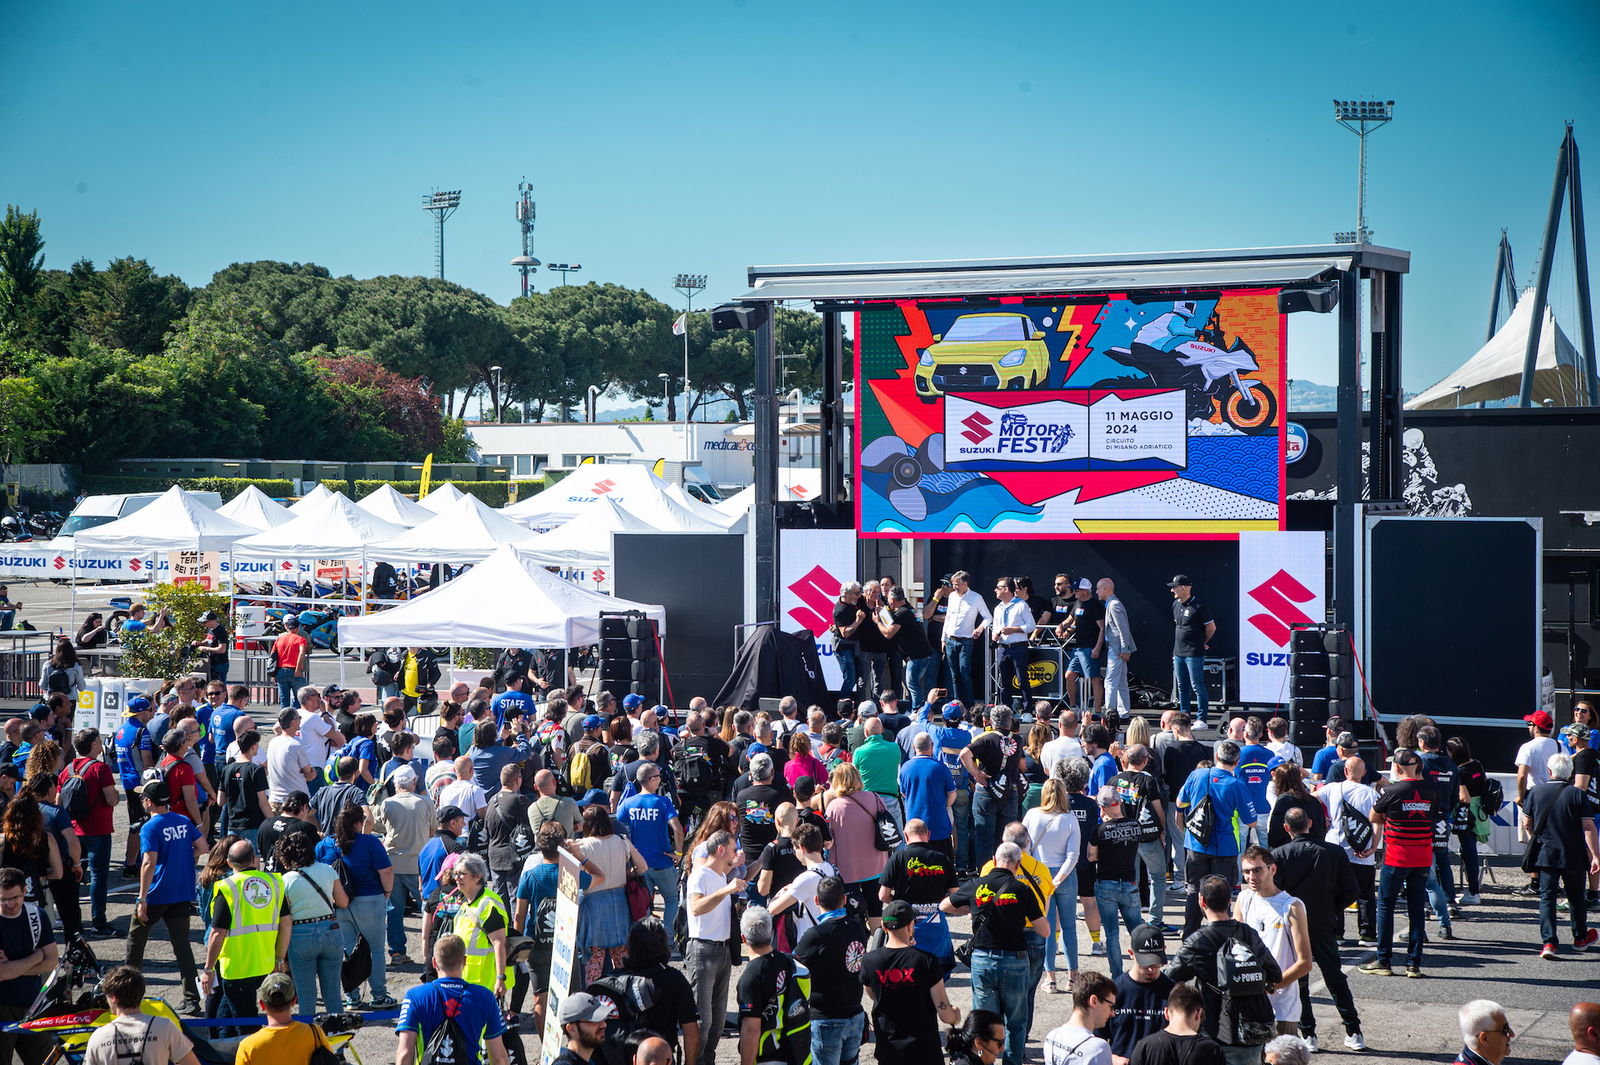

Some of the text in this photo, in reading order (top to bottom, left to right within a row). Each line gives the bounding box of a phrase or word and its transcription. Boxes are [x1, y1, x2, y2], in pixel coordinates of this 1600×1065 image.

[1190, 343, 1216, 354] SUZUKI
[1105, 411, 1173, 421] 11 MAGGIO
[1000, 424, 1059, 437] MOTOR
[1105, 424, 1137, 434] 2024
[997, 437, 1052, 453] FEST
[68, 559, 122, 569] SUZUKI
[220, 562, 273, 572] SUZUKI
[500, 699, 525, 709] STAFF
[629, 807, 659, 821] STAFF
[163, 824, 188, 841] STAFF
[1104, 826, 1142, 839] BOXEUR
[876, 967, 915, 984] VOX
[1241, 972, 1263, 983] POWER
[101, 1035, 158, 1048] HORSEPOWER
